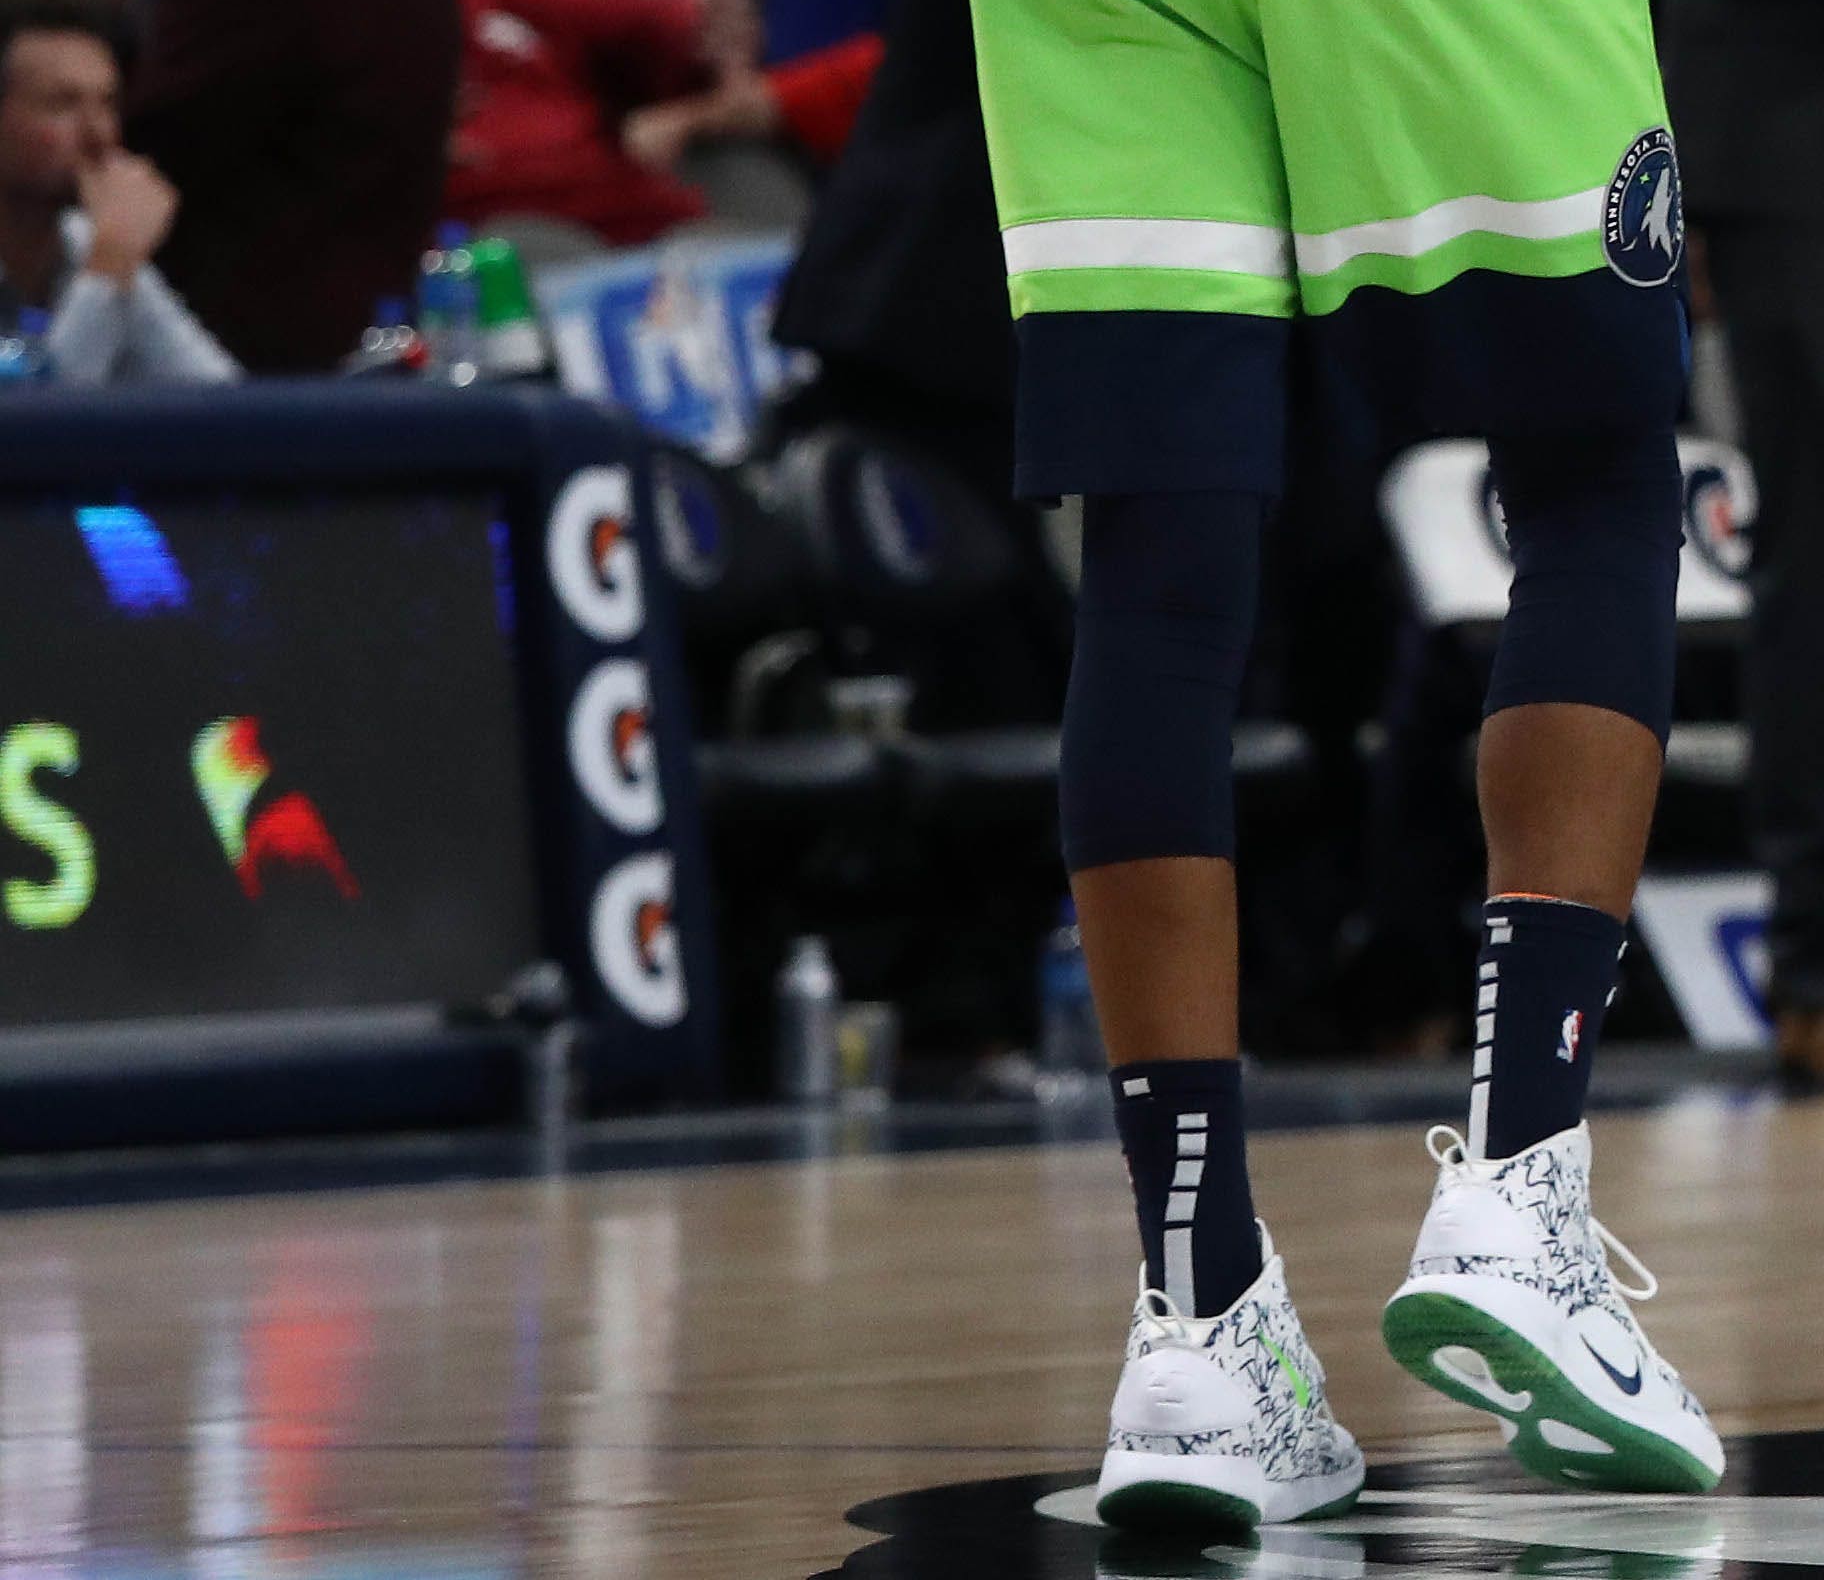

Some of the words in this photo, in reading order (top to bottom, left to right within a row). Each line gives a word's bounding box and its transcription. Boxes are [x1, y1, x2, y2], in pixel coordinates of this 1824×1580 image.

[1608, 139, 1651, 243] MINNESOTA
[546, 464, 646, 644] G
[0, 720, 96, 931] S
[567, 656, 666, 837] G
[589, 851, 688, 1028] G
